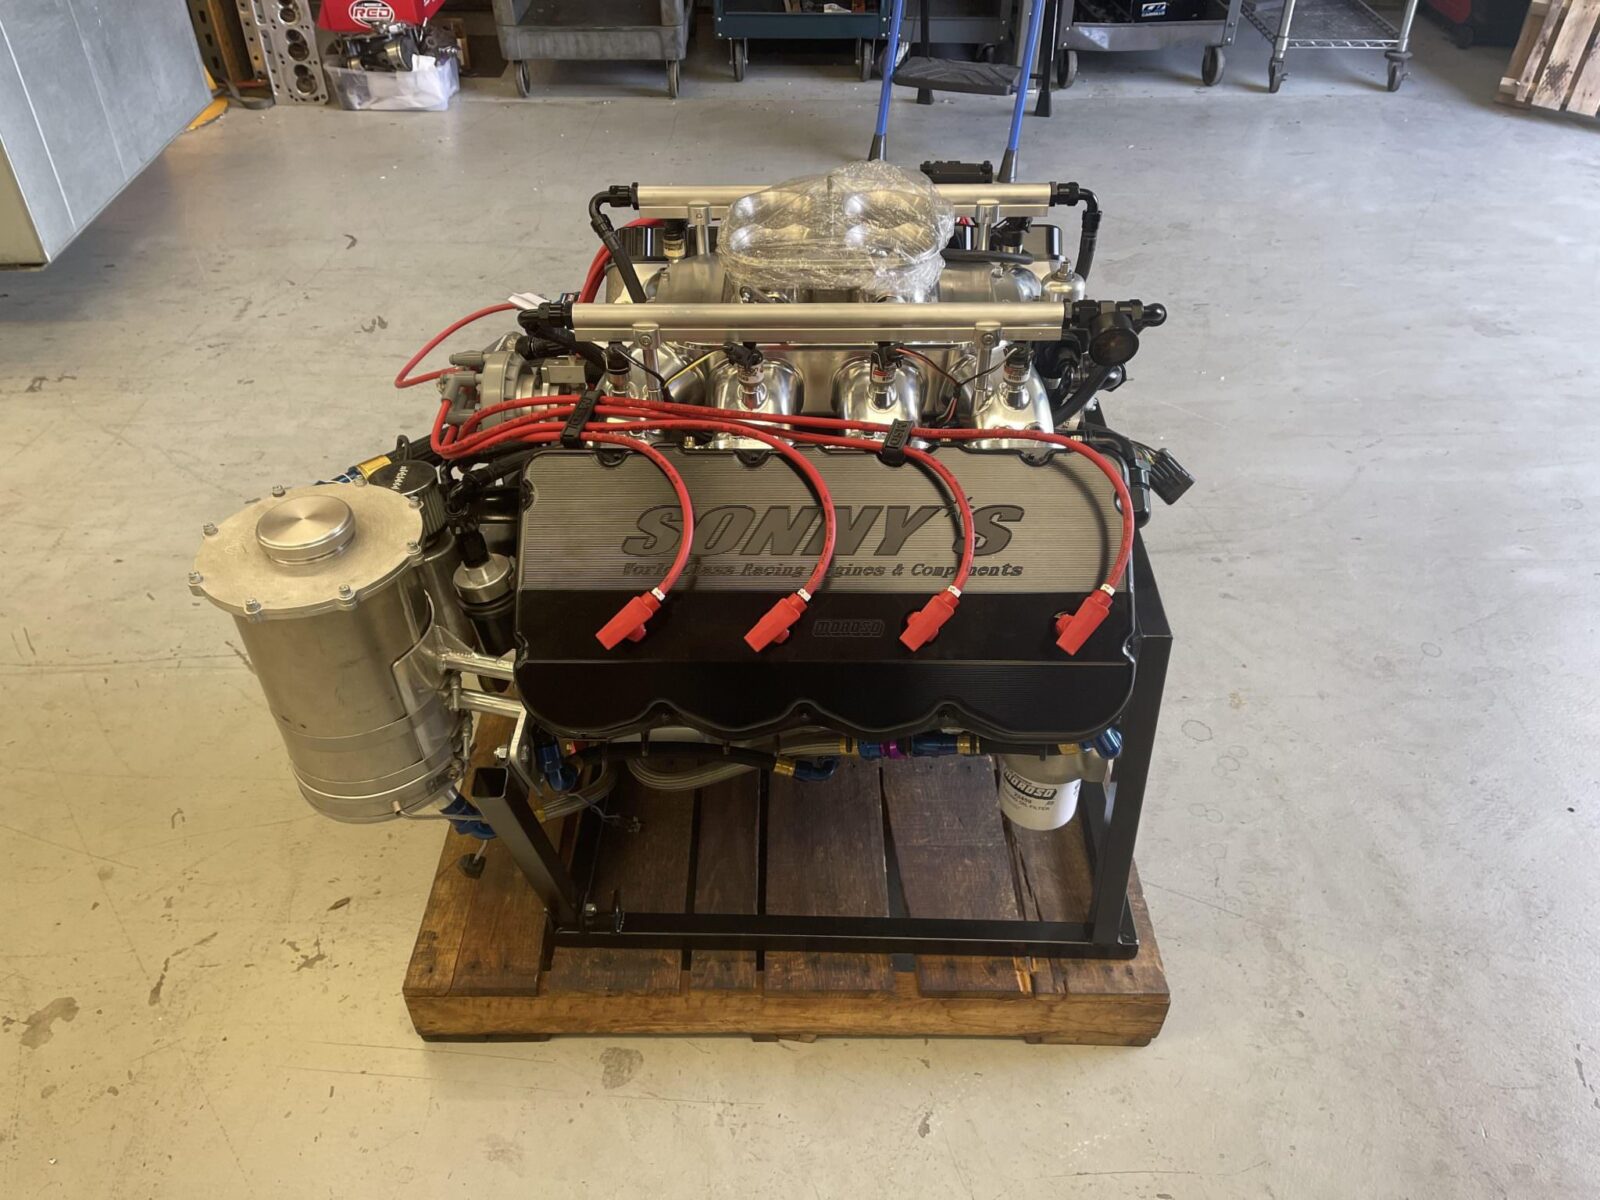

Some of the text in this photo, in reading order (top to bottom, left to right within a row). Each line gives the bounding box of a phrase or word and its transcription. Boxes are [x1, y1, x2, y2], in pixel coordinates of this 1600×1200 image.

[354, 7, 391, 18] RED
[740, 562, 805, 578] Racing
[811, 562, 885, 578] gines
[891, 562, 905, 577] &
[910, 562, 1024, 579] Compnents
[813, 619, 884, 637] MOROSO
[1004, 769, 1057, 800] MOROSO
